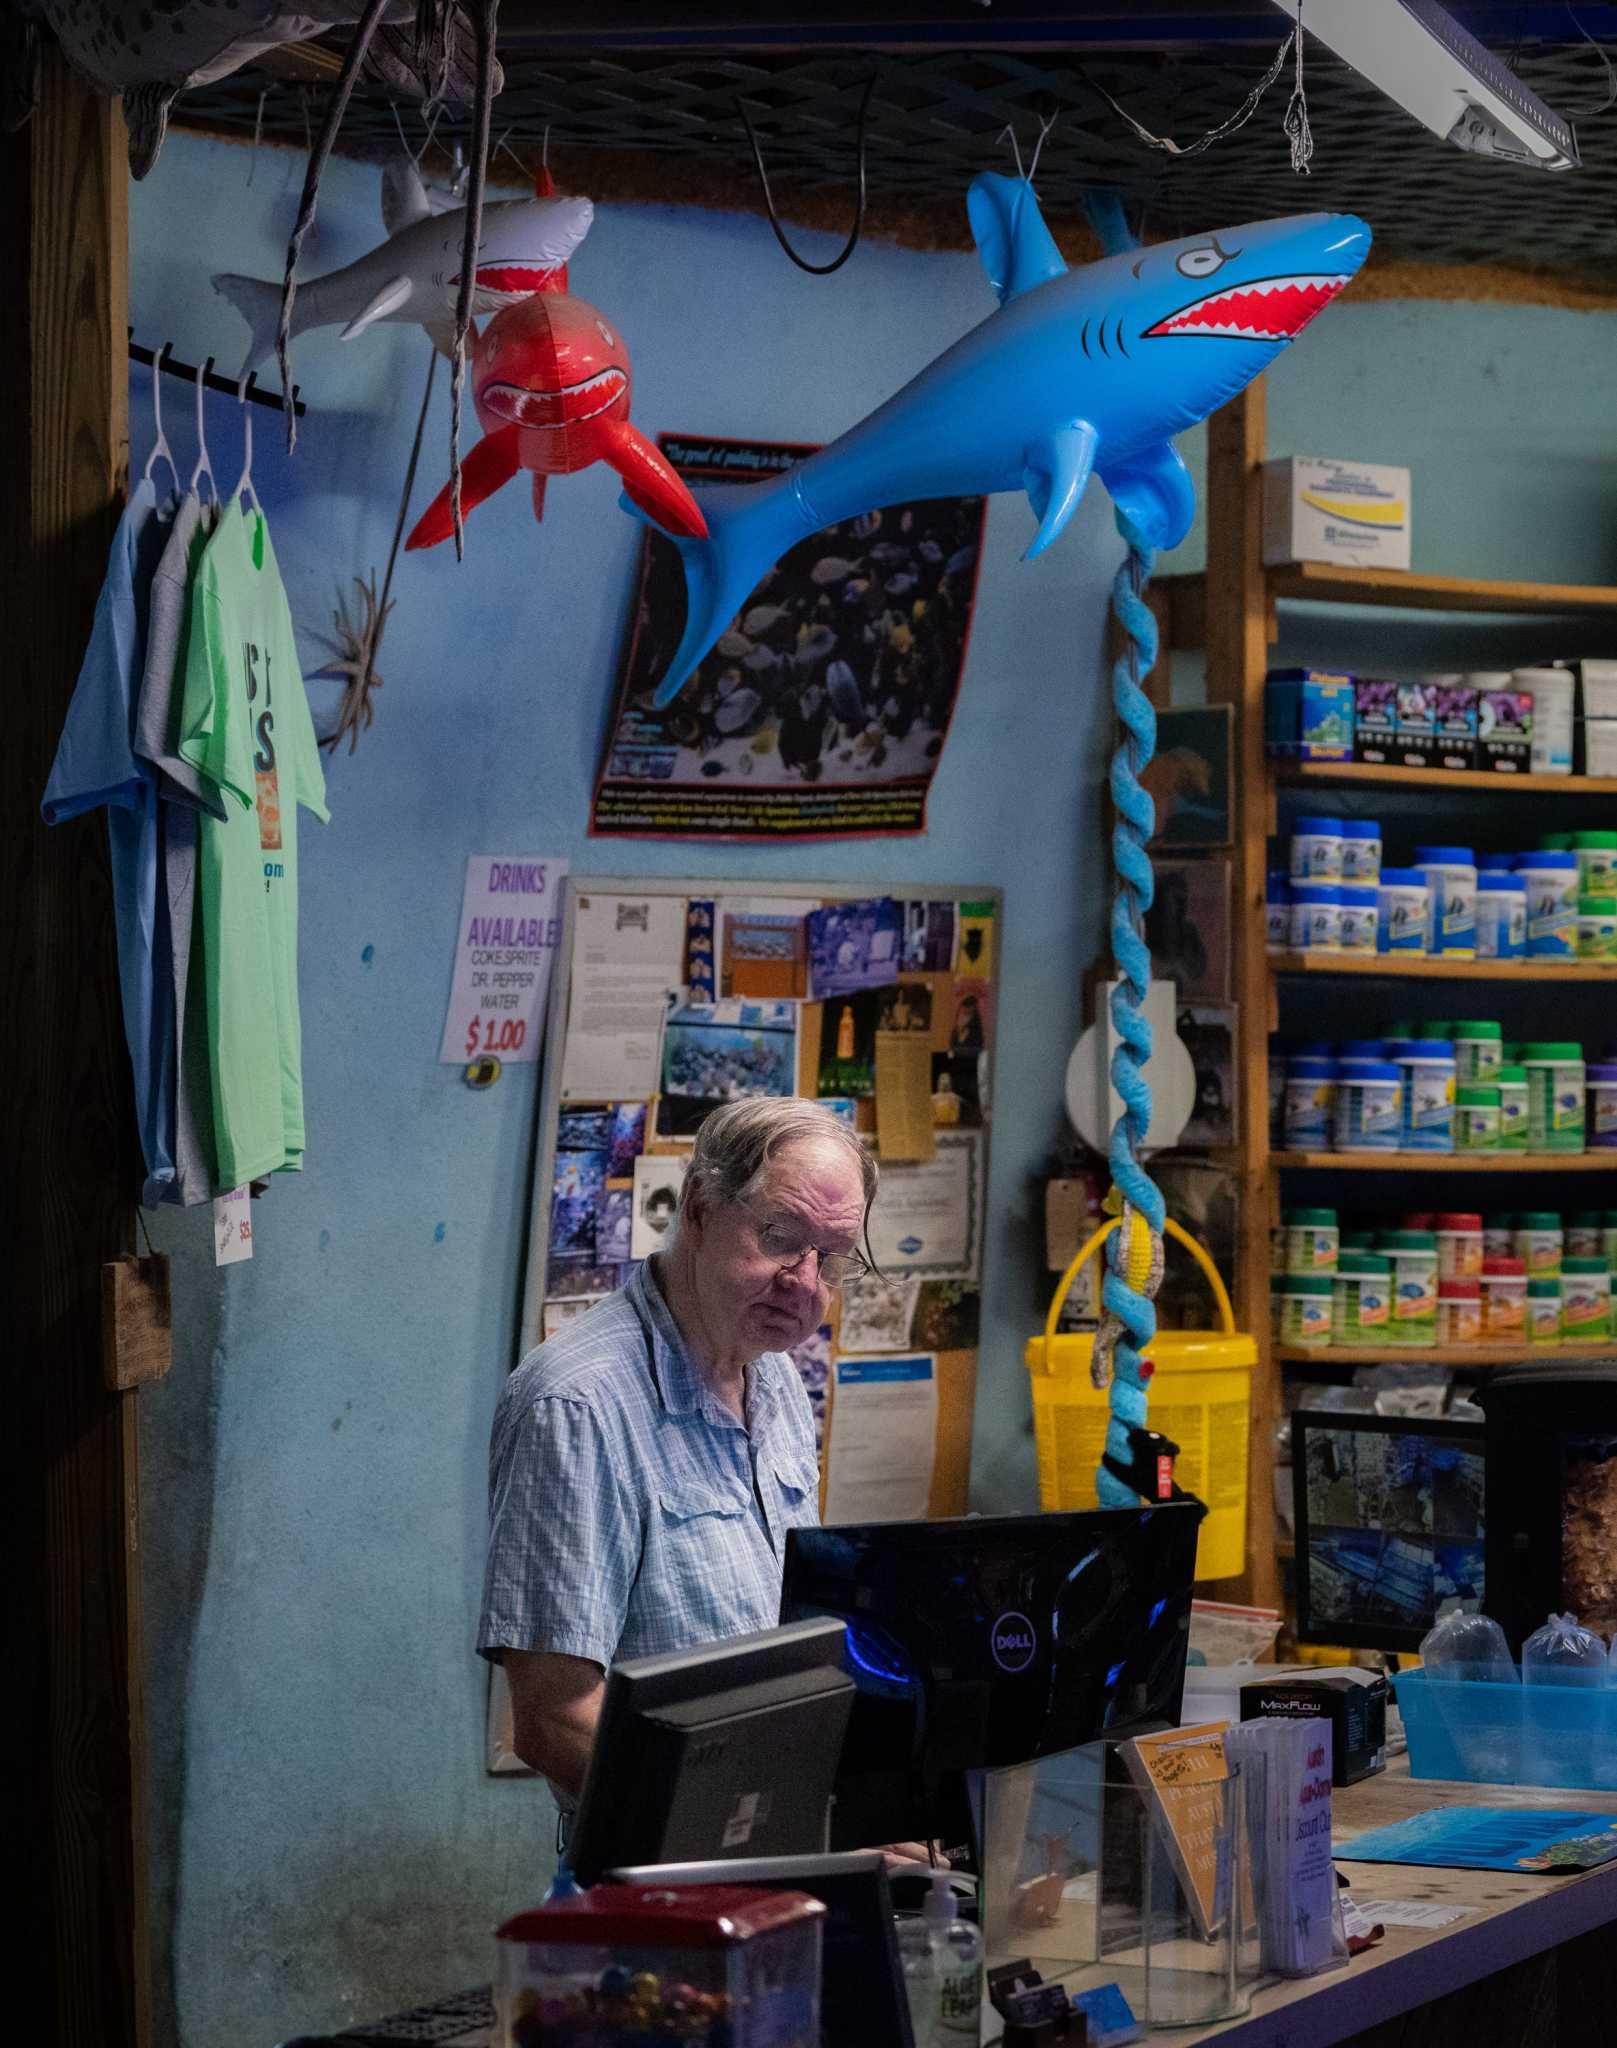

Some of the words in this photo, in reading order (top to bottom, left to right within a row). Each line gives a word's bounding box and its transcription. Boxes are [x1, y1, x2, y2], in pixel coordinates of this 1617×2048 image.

[488, 863, 547, 893] DRINKS
[467, 917, 563, 948] AVAILABLE
[493, 972, 535, 988] PEPPER
[480, 994, 519, 1010] WATER
[996, 1633, 1032, 1650] DELL
